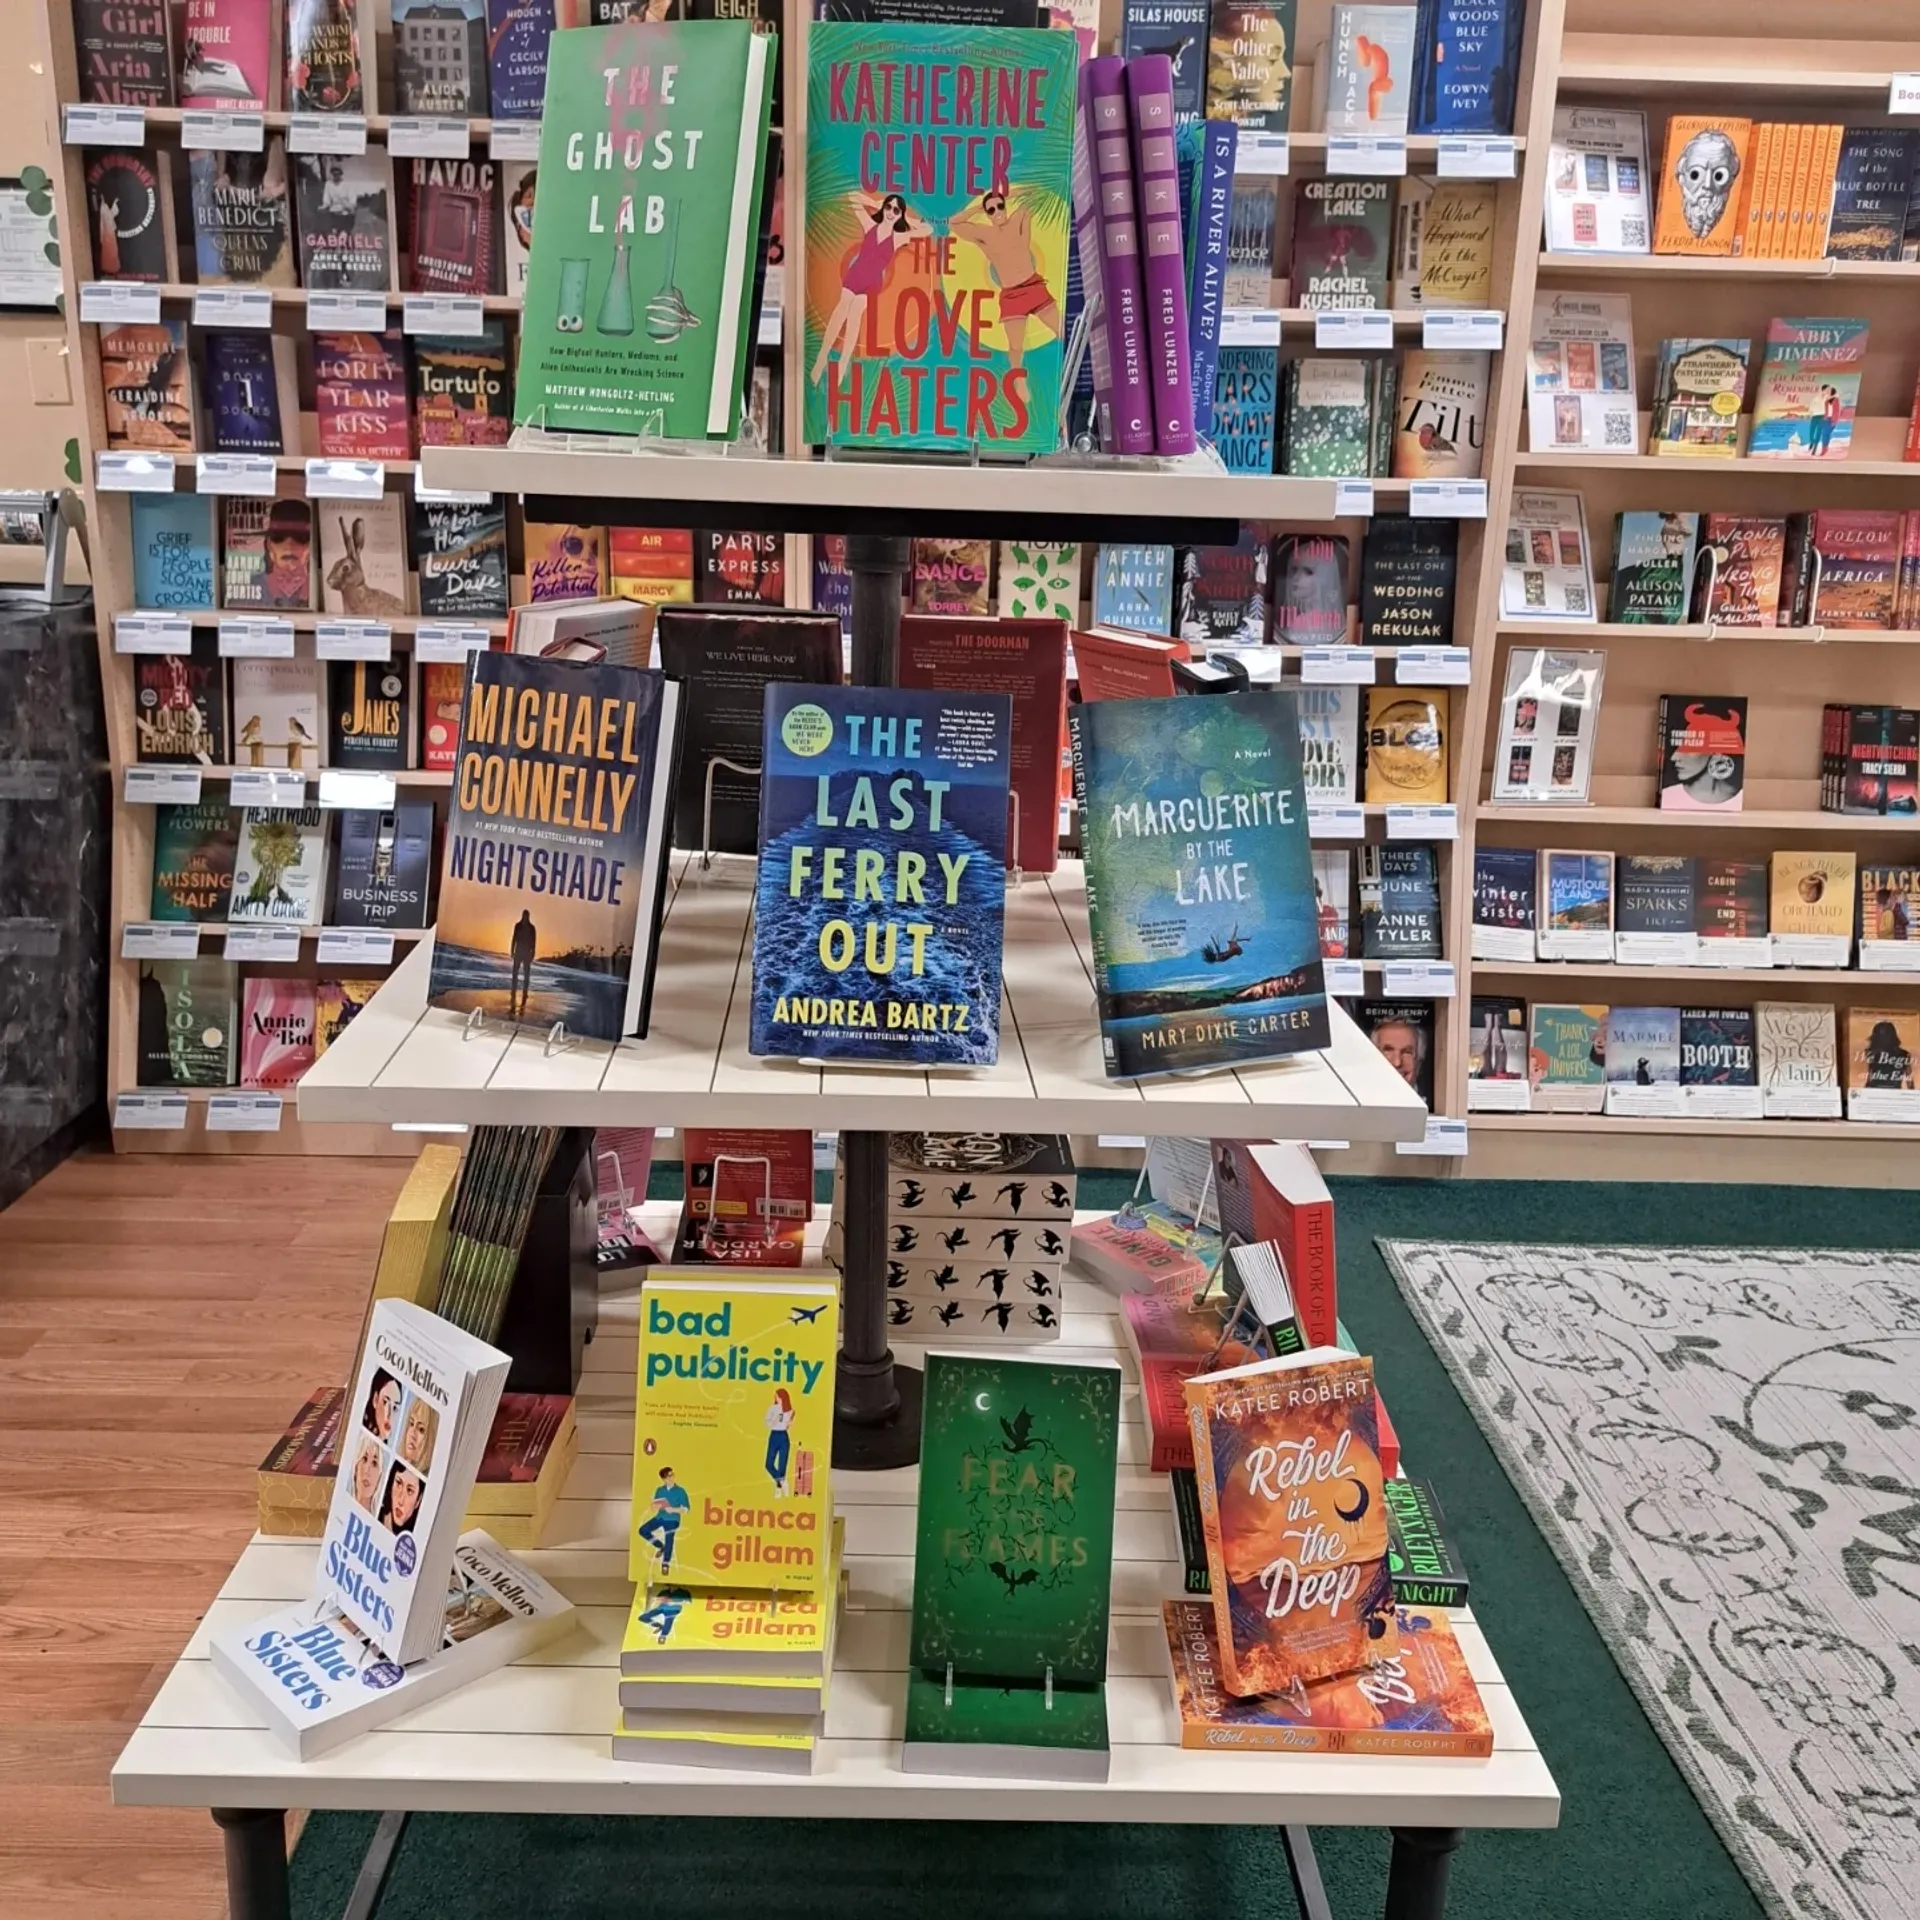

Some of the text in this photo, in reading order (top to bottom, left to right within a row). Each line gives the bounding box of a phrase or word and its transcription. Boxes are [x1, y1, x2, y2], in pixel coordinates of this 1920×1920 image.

[507, 8, 541, 17] HIDDEN
[1128, 8, 1205, 23] SILAS HOUSE
[1448, 11, 1500, 22] WOODS
[103, 9, 164, 36] Girl
[515, 22, 535, 32] LIFE
[1241, 14, 1268, 32] The
[1455, 25, 1489, 37] BLUE
[188, 26, 231, 43] TROUBLE
[1233, 39, 1273, 58] Other
[1458, 40, 1483, 52] SKY
[91, 53, 150, 78] Aria
[510, 52, 543, 62] CECILY
[1230, 62, 1272, 84] Valley
[603, 65, 678, 106] THE
[829, 61, 1049, 129] KATHERINE
[1443, 83, 1489, 95] EOWYN
[1452, 98, 1479, 110] IVEY
[566, 129, 703, 170] GHOST
[861, 131, 1012, 198] CENTER
[413, 160, 493, 190] HAVOC
[1305, 182, 1386, 199] CREATION
[199, 207, 276, 227] BENEDICT
[589, 195, 665, 233] LAB
[1324, 201, 1366, 216] LAKE
[307, 233, 383, 248] GABRIELE
[1200, 136, 1230, 339] IS A RIVER ALIVE?
[910, 237, 957, 275] THE
[1309, 278, 1368, 293] RACHEL
[1300, 294, 1376, 310] KUSHNER
[866, 287, 995, 360] LOVE
[1121, 288, 1138, 387] FRED LUNZER
[1162, 288, 1178, 387] FRED LUNZER
[1794, 330, 1844, 343] ABBY
[567, 347, 592, 358] Bigfoot
[1774, 347, 1857, 362] JIMENEZ
[420, 366, 500, 394] Tartufo
[540, 362, 684, 379] Alien Enthusiasts Are Wrecking Science
[332, 389, 390, 408] YEAR
[545, 384, 675, 402] MATTHEW HONGOLTZ-HETLING
[827, 361, 1029, 440] HATERS
[337, 415, 387, 434] KISS
[1400, 397, 1484, 448] Tilt
[157, 532, 192, 544] GRIEF
[642, 535, 662, 546] AIR
[712, 533, 776, 552] PARIS
[1823, 530, 1892, 543] FOLLOW
[162, 559, 212, 573] PEOPLE
[426, 555, 479, 577] Laura
[708, 559, 780, 573] EXPRESS
[1108, 550, 1165, 566] AFTER
[915, 564, 986, 581] DANCE
[1106, 572, 1165, 588] ANNIE
[1821, 570, 1884, 583] AFRICA
[446, 574, 501, 596] Dave
[633, 585, 673, 596] MARCY
[1374, 585, 1444, 598] WEDDING
[1626, 580, 1683, 592] ALLISON
[155, 591, 214, 606] CROSLEY
[728, 590, 761, 600] EMMA
[1629, 593, 1678, 606] PATAKI
[928, 601, 970, 612] TORREY
[1382, 608, 1433, 620] JASON
[1372, 623, 1441, 637] REKULAK
[955, 635, 1030, 649] THE DOORMAN
[467, 683, 639, 763] MICHAEL
[846, 715, 922, 759] THE
[459, 753, 636, 834] CONNELLY
[817, 775, 950, 832] LAST
[246, 807, 320, 828] HEARTWOOD
[1112, 790, 1295, 839] MARGUERITE
[485, 823, 498, 832] NEW
[500, 824, 516, 834] YORK
[517, 826, 536, 836] TIMES
[537, 829, 577, 844] BESTSELLING
[579, 836, 604, 847] AUTHOR
[1186, 839, 1233, 859] BY THE
[1380, 852, 1421, 861] THREE
[450, 835, 625, 905] NIGHTSHADE
[790, 846, 971, 904] FERRY
[1384, 862, 1417, 872] DAYS
[158, 872, 232, 888] MISSING
[367, 874, 396, 887] THE
[1175, 863, 1249, 905] LAKE
[1382, 882, 1422, 892] JUNE
[1552, 879, 1608, 890] MUSTIQUE
[1862, 871, 1920, 892] BLACK
[173, 893, 218, 908] HALF
[343, 888, 417, 902] BUSINESS
[1626, 898, 1687, 911] SPARKS
[363, 904, 397, 917] TRIP
[1481, 903, 1534, 919] sister
[1378, 915, 1428, 926] ANNE
[1376, 929, 1431, 942] TYLER
[819, 919, 933, 975] OUT
[772, 997, 970, 1032] ANDREA BARTZ
[1366, 1008, 1428, 1017] BEING HENRY
[252, 1012, 306, 1035] Annie
[1142, 1011, 1311, 1050] MARY DIXIE CARTER
[1612, 1030, 1675, 1043] MARMEE
[1682, 1044, 1751, 1068] BOOTH
[1788, 1064, 1822, 1081] Iain
[1308, 1210, 1323, 1316] THE BOOK OF
[648, 1298, 732, 1337] bad
[375, 1334, 450, 1406] Coco Mellors
[645, 1344, 826, 1394] publicity
[1215, 1378, 1369, 1419] KATEE ROBERT
[1246, 1429, 1356, 1501] Rebel
[961, 1455, 1076, 1500] FEAR
[703, 1499, 816, 1532] bianca
[1288, 1491, 1317, 1522] in
[343, 1511, 392, 1584] Blue
[1283, 1523, 1347, 1561] the
[712, 1536, 815, 1570] gillam
[325, 1539, 395, 1634] Sisters
[455, 1546, 491, 1578] Coco
[488, 1571, 540, 1617] Mellors
[1260, 1558, 1361, 1620] Deep
[1403, 1584, 1457, 1605] NIGHT
[712, 1619, 816, 1639] gillam
[293, 1624, 358, 1682] Blue
[1194, 1604, 1221, 1718] KATEE ROBERT
[244, 1630, 331, 1711] Sisters
[1356, 1736, 1457, 1752] KATEE ROBERT
